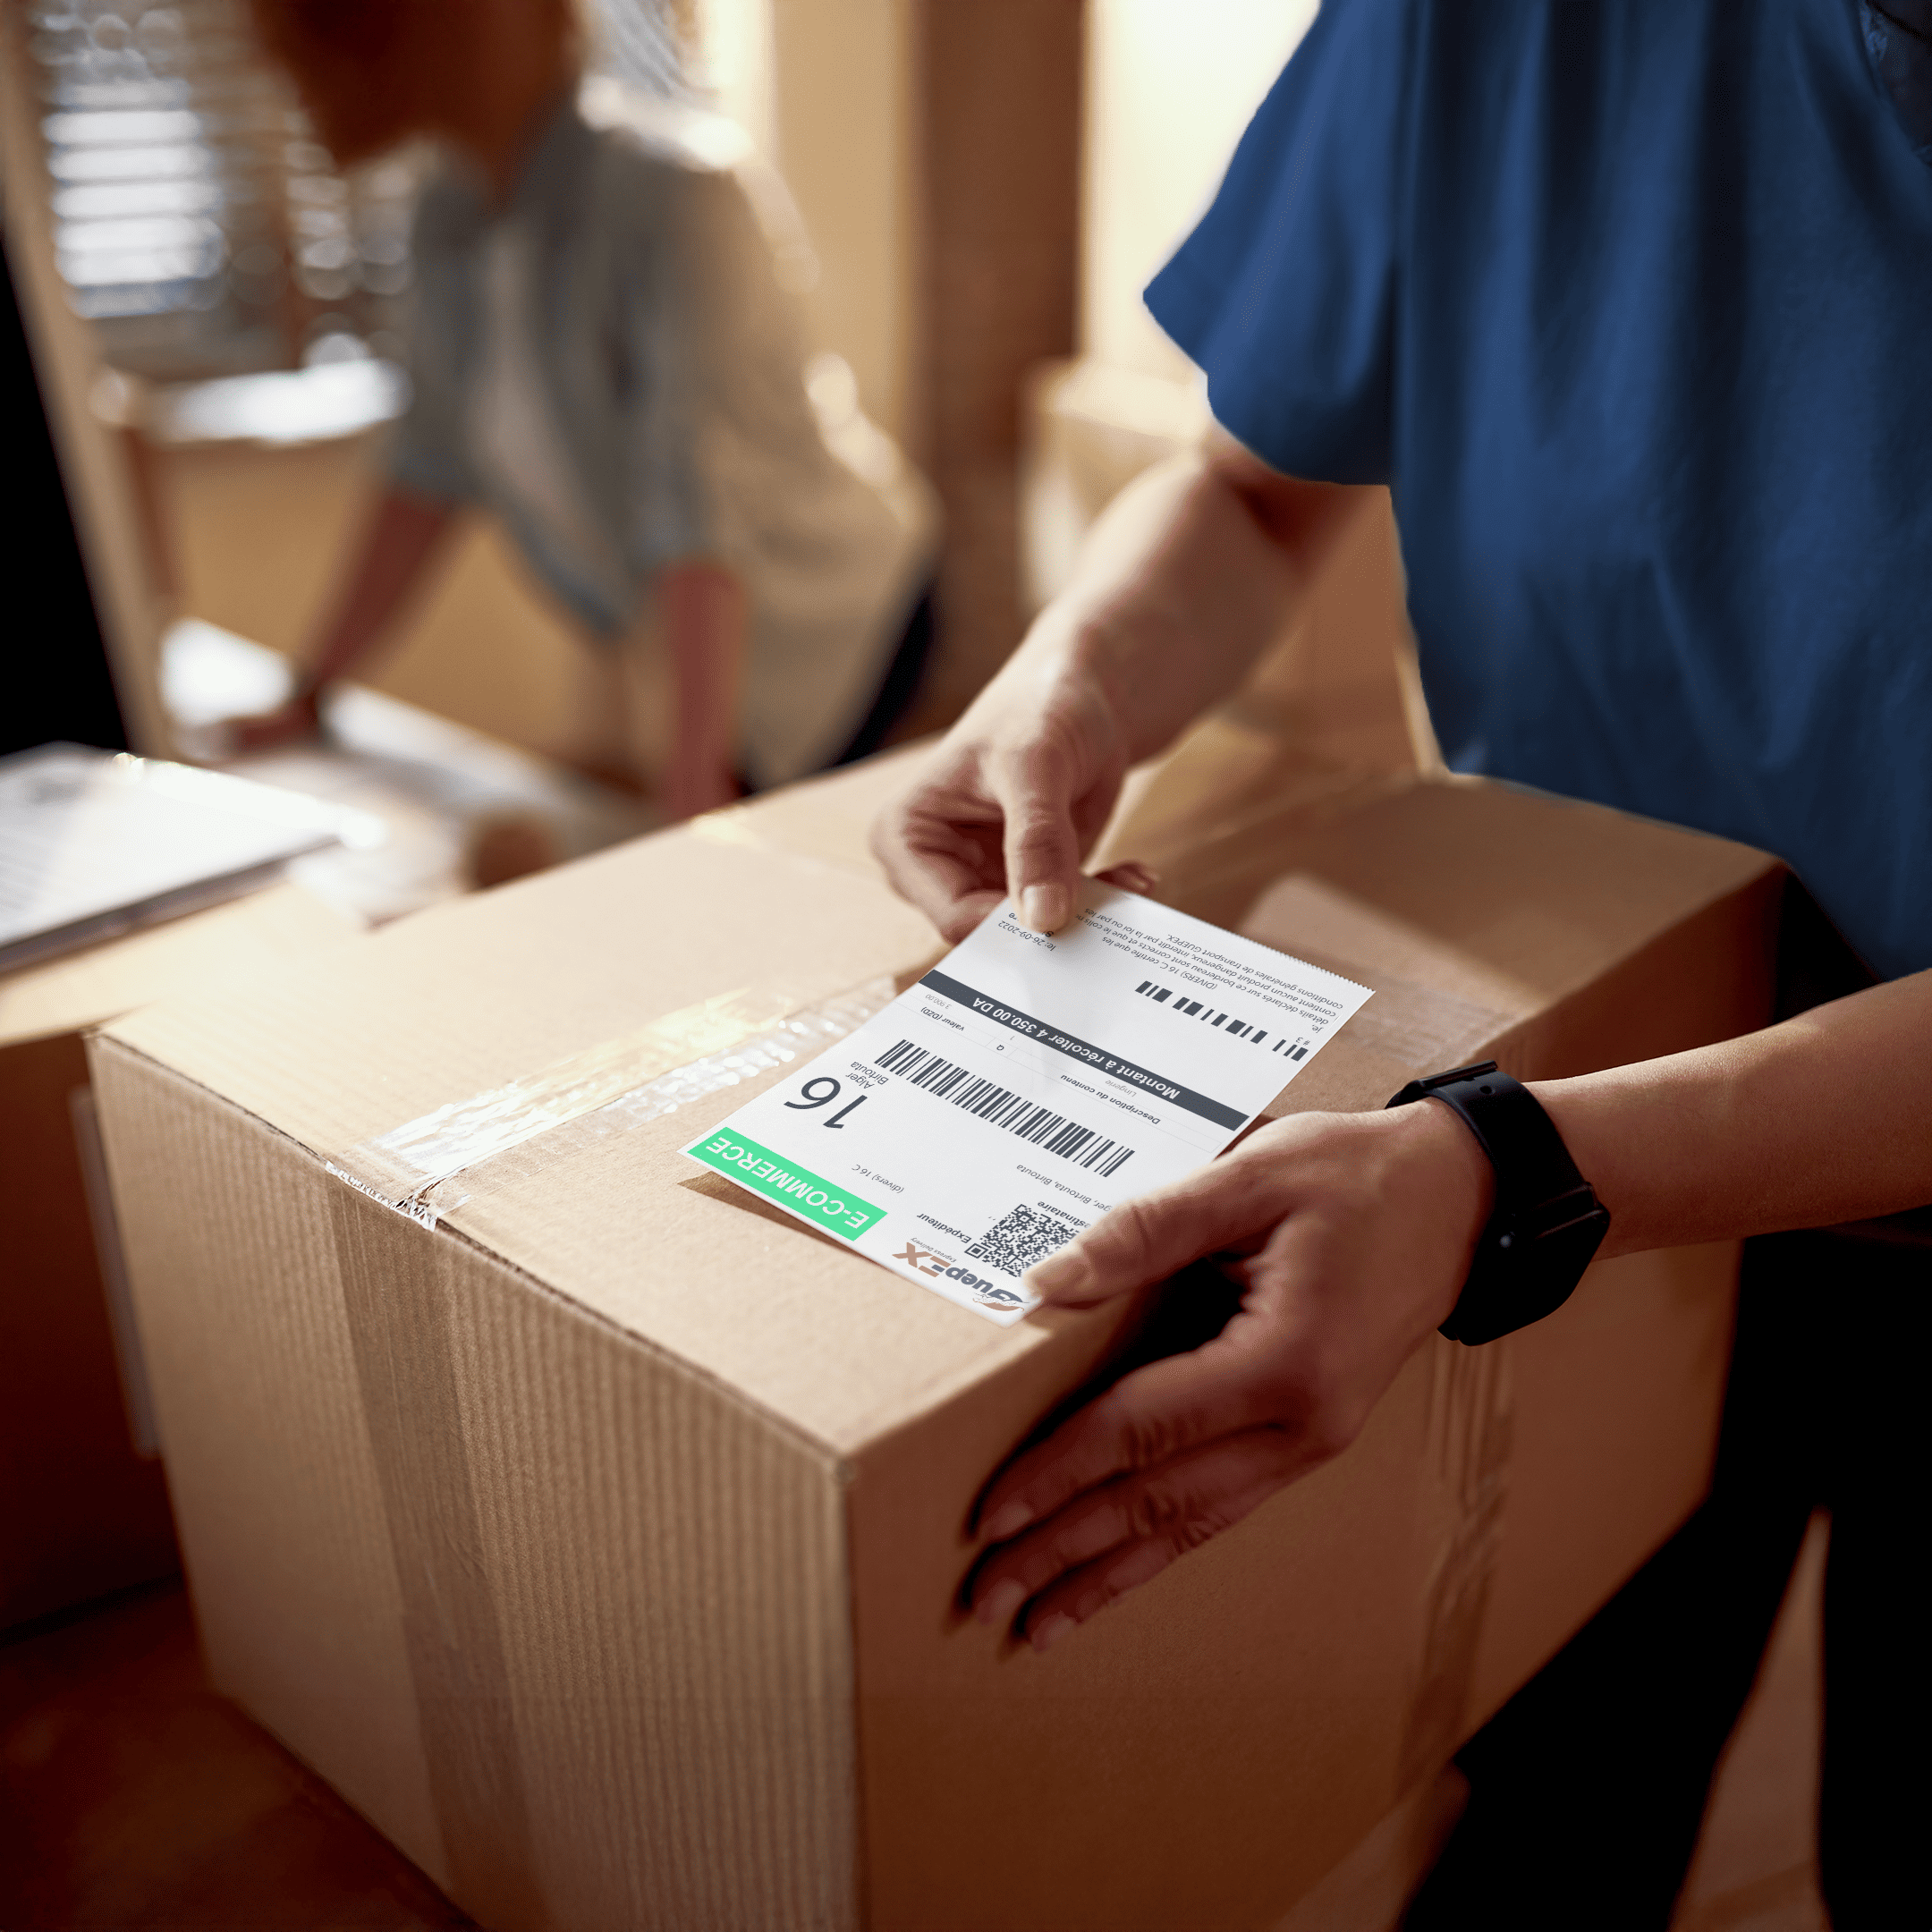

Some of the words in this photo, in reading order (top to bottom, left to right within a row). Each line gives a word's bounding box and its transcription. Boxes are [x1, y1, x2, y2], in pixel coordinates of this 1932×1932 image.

[1084, 917, 1103, 929] colis
[1095, 913, 1113, 924] par
[1110, 919, 1124, 928] ou
[998, 920, 1049, 946] 26-09-2022
[1102, 926, 1113, 936] le
[1111, 930, 1129, 941] que
[1122, 925, 1136, 936] loi
[1134, 930, 1144, 939] la
[1101, 936, 1115, 946] les
[1113, 941, 1131, 953] que
[1127, 937, 1139, 945] et
[1142, 935, 1160, 945] par
[1166, 934, 1202, 953] GUEPEX.
[1138, 943, 1171, 959] corrects
[1157, 941, 1190, 957] interdit
[1131, 950, 1159, 964] certifie
[1171, 957, 1191, 968] sont
[1202, 950, 1241, 969] transport
[1167, 965, 1181, 975] 16
[1191, 953, 1237, 977] dangereux,
[1241, 966, 1255, 975] de
[1180, 971, 1217, 990] (DIVERS)
[1191, 965, 1235, 987] bordereau
[1237, 975, 1272, 990] produit
[1254, 971, 1298, 991] générales
[1234, 983, 1248, 992] ce
[1246, 988, 1263, 998] sur
[1271, 988, 1299, 1002] aucun
[973, 998, 994, 1013] DA
[1262, 995, 1299, 1013] déclarés
[1297, 988, 1343, 1009] conditions
[920, 1006, 943, 1021] (DZD)
[1299, 999, 1336, 1017] contient
[941, 1018, 964, 1031] valeur
[993, 1009, 1037, 1032] 350.00
[1299, 1010, 1329, 1025] détails
[1036, 1029, 1048, 1038] 4
[1294, 1036, 1304, 1044] 3
[1048, 1036, 1105, 1063] récolter
[1104, 1059, 1117, 1071] à
[845, 1071, 876, 1089] Alger
[851, 1062, 889, 1085] Birtouta
[1061, 1075, 1096, 1093] contenu
[1105, 1080, 1137, 1097] Lingerie
[1116, 1065, 1180, 1099] Montant
[1095, 1090, 1109, 1100] du
[784, 1077, 868, 1129] 16
[1109, 1097, 1161, 1124] Description
[851, 1163, 861, 1172] C
[859, 1167, 873, 1178] 16
[1016, 1165, 1053, 1185] Birtouta
[706, 1137, 869, 1228] E-COMMERCE
[871, 1174, 904, 1193] (divers)
[1055, 1182, 1092, 1204] Birtouta,
[1038, 1201, 1089, 1227] estinataire
[917, 1214, 972, 1243] Expéditeur
[911, 1237, 934, 1251] Delivery
[934, 1250, 957, 1263] Express
